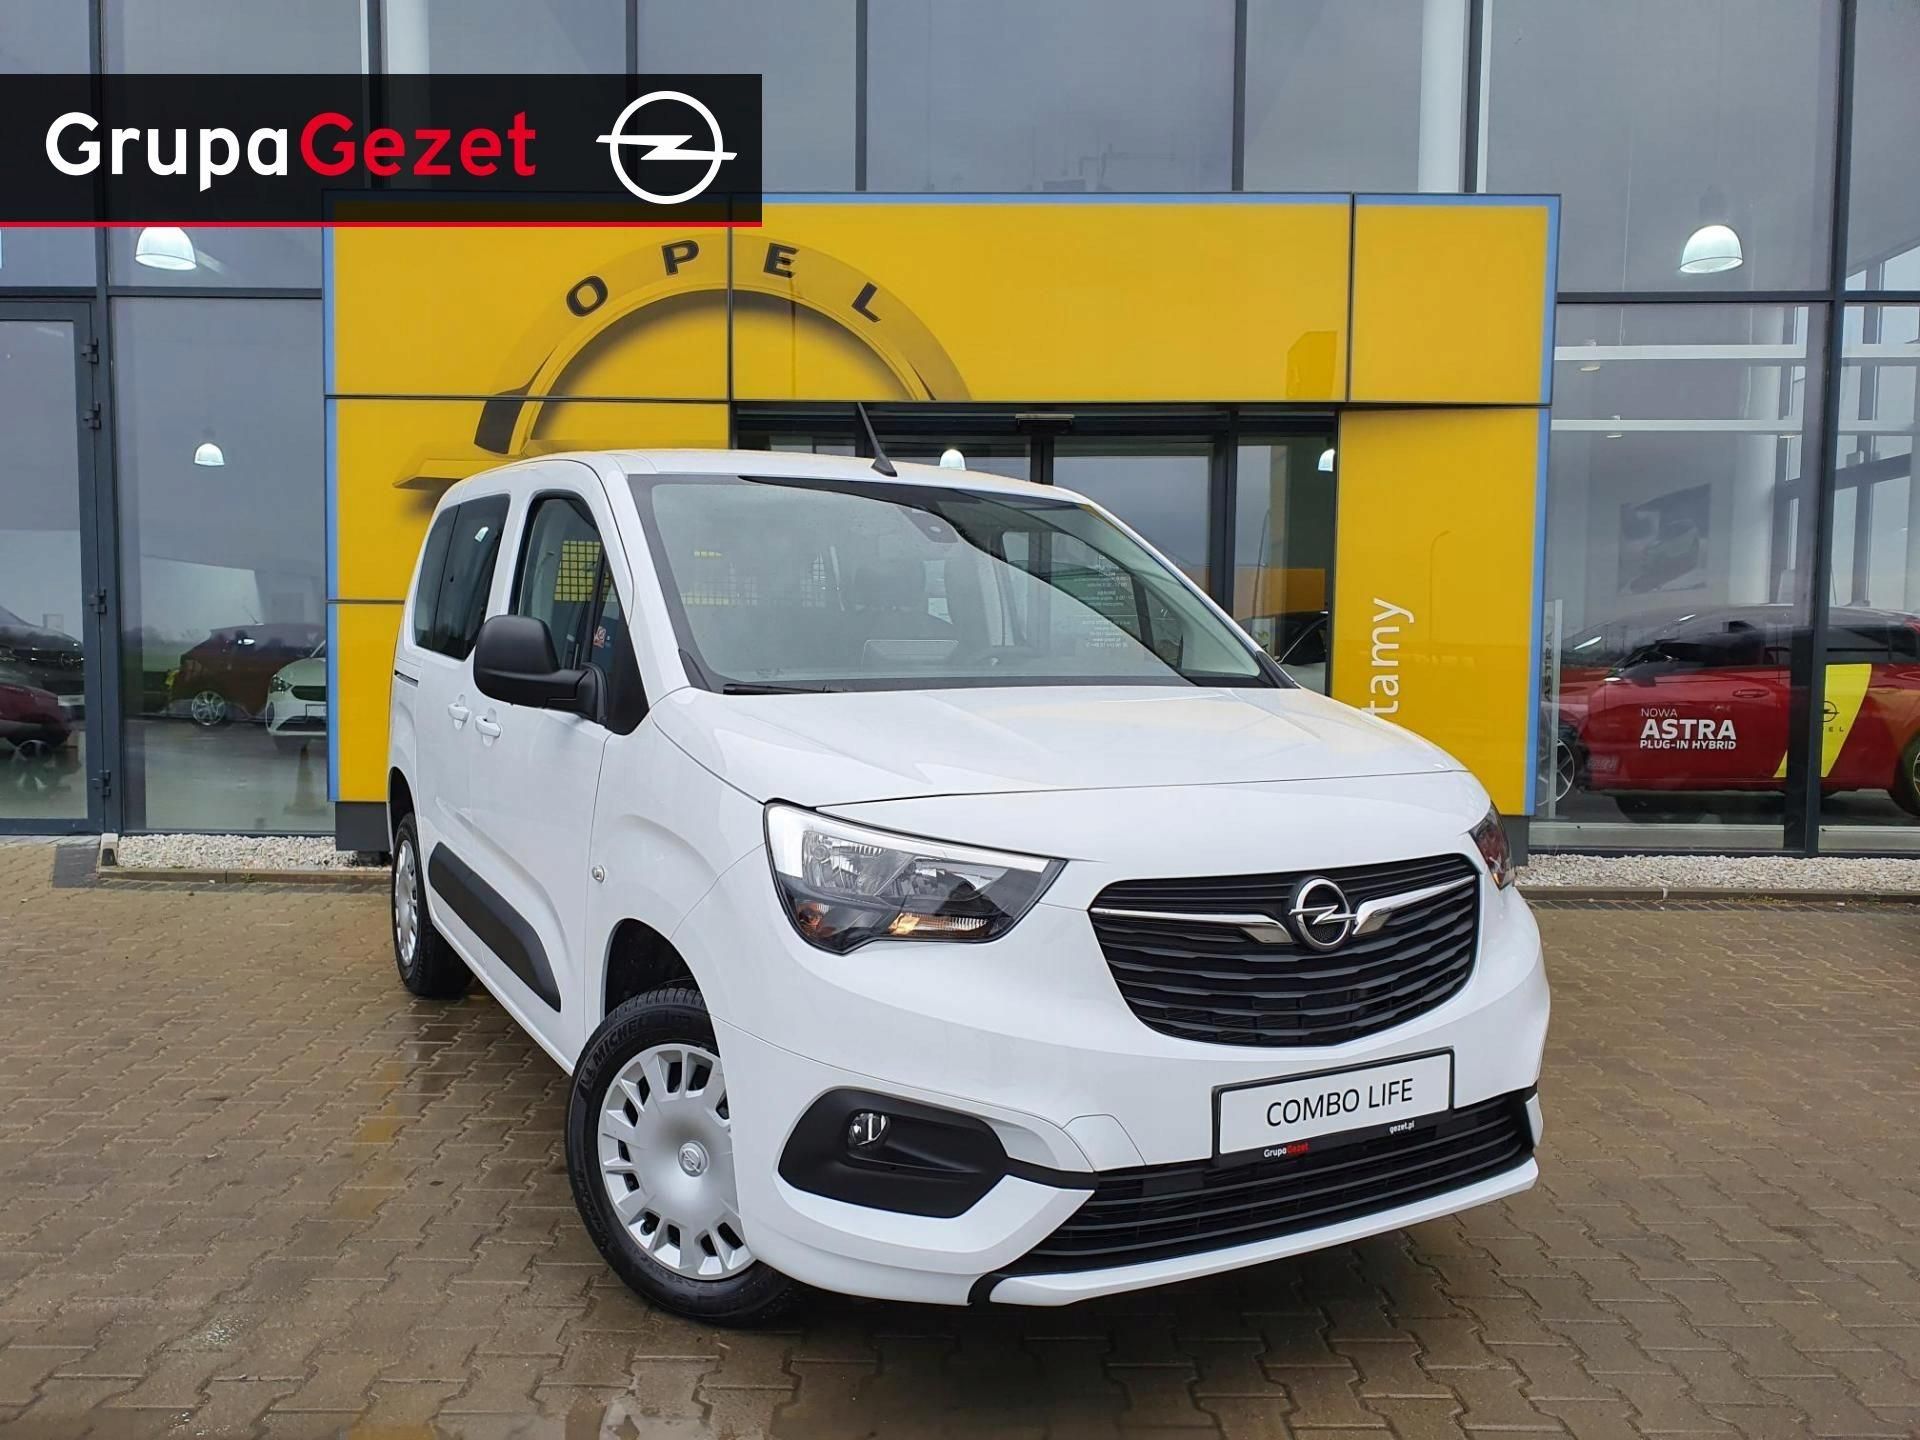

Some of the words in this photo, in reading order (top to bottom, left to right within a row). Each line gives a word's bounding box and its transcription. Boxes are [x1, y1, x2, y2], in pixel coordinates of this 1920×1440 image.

[566, 239, 882, 323] OPEL
[1361, 597, 1415, 717] tamy
[1640, 708, 1678, 718] NOWA
[1640, 718, 1737, 740] ASTRA
[1639, 739, 1689, 749] PLUG-IN
[1692, 740, 1737, 750] HYBRID
[1266, 1088, 1360, 1127] COMBO
[1368, 1078, 1414, 1109] LIFE
[1389, 1120, 1415, 1134] gezet.pl
